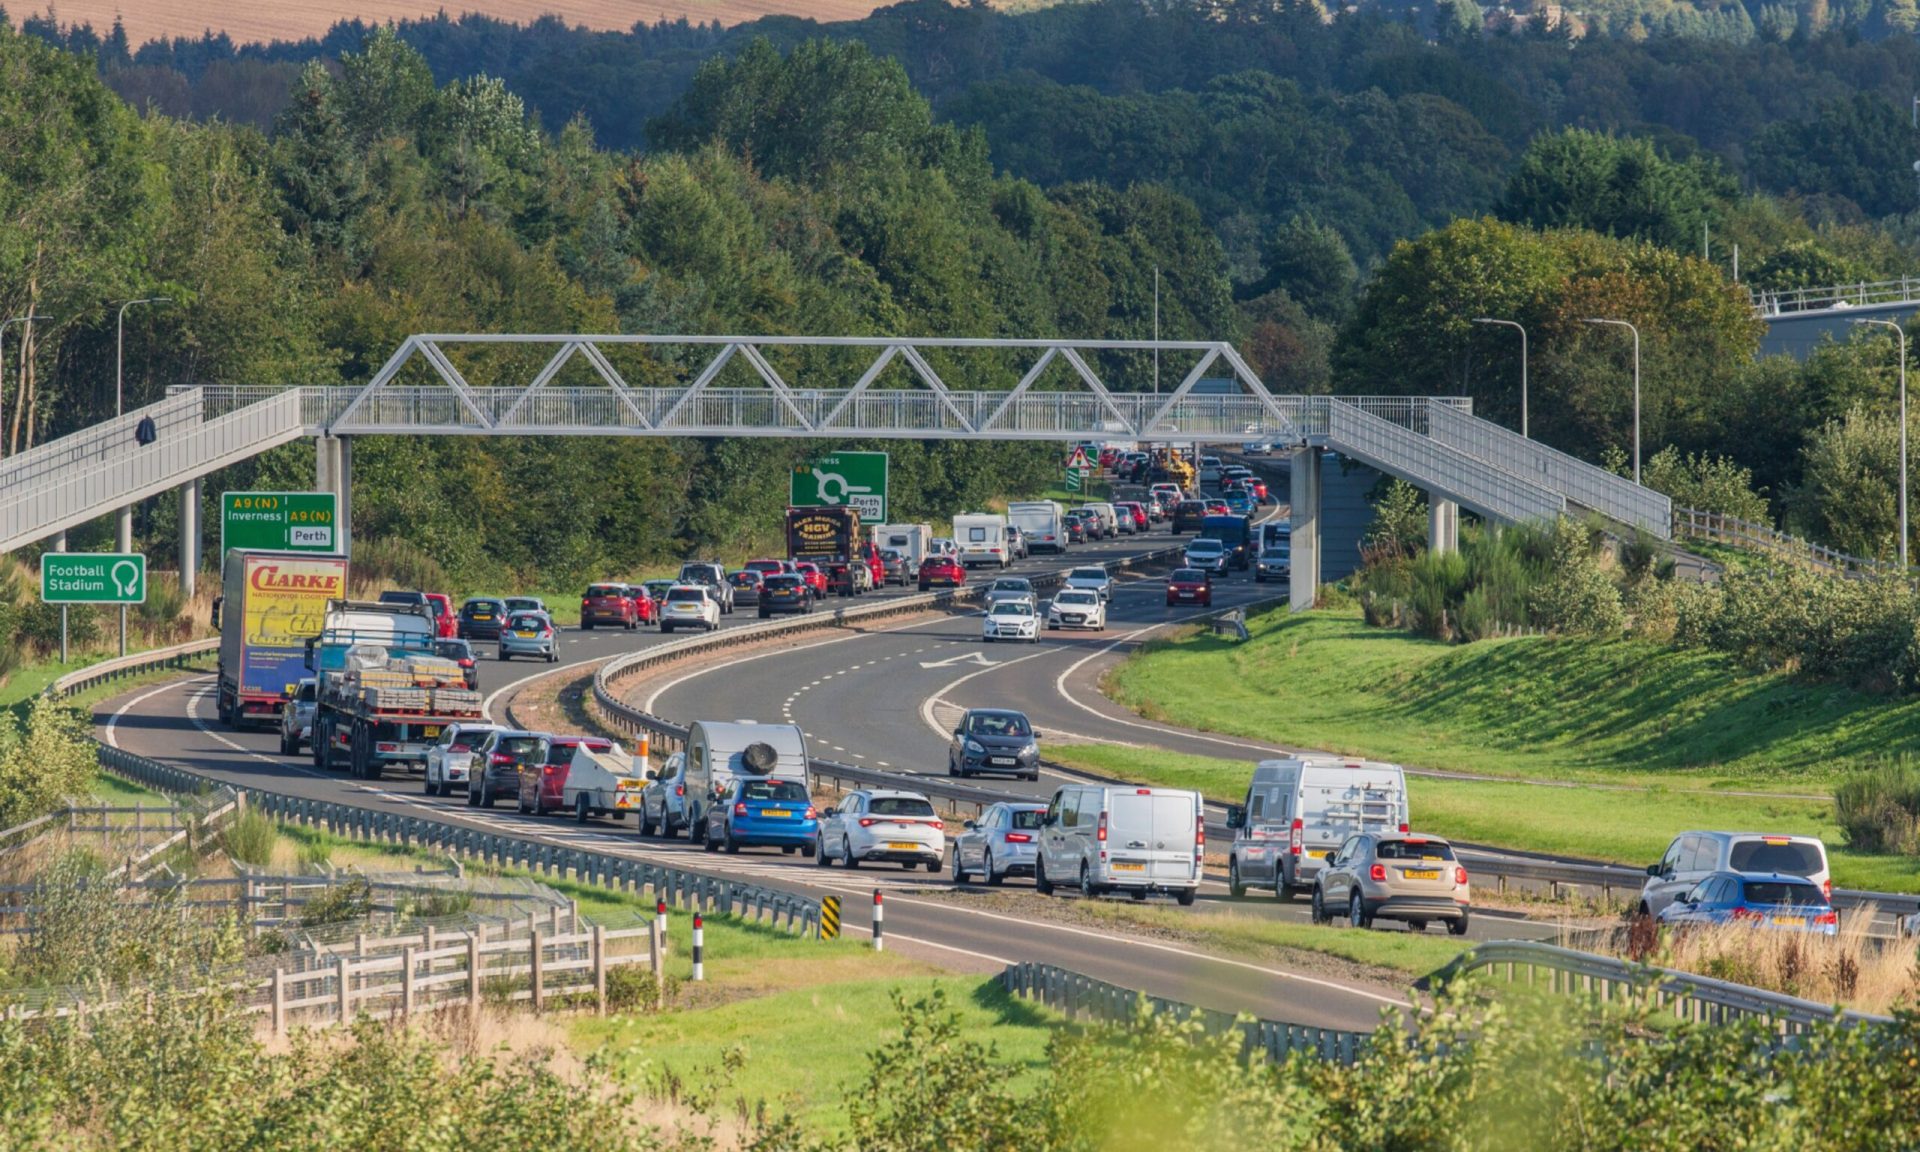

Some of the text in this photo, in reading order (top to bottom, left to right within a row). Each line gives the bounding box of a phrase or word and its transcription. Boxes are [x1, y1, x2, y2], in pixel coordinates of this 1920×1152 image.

[853, 498, 879, 506] Perth
[228, 510, 281, 521] Inverness
[861, 508, 878, 516] 912
[804, 524, 830, 532] HGV
[295, 531, 327, 541] Perth
[799, 529, 836, 540] TRAINING
[49, 565, 105, 577] Football
[49, 579, 104, 591] Stadium
[251, 566, 340, 593] CLARKE
